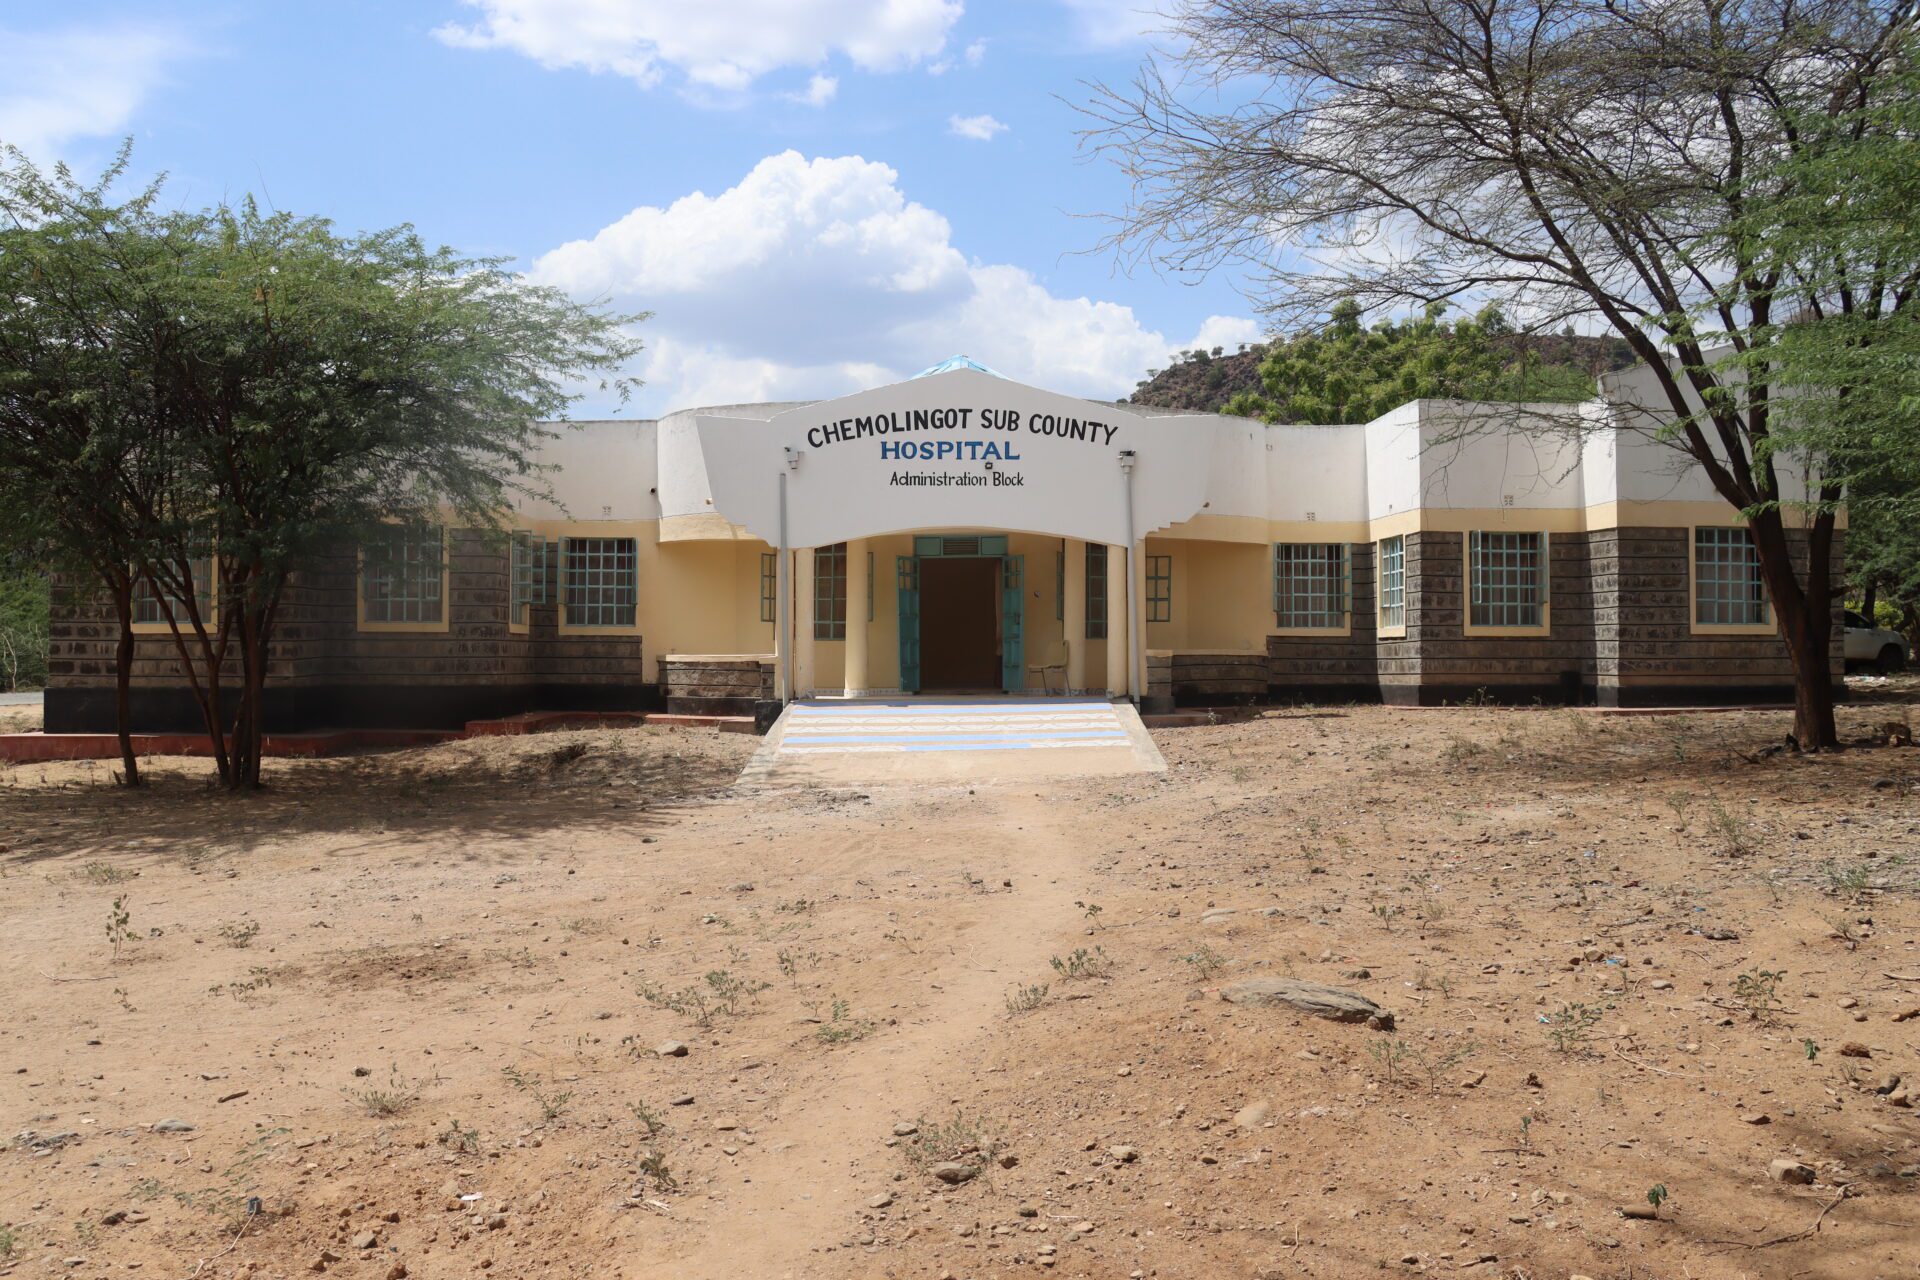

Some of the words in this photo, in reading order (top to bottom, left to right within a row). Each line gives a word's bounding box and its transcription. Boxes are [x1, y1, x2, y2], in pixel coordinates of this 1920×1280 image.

[807, 408, 973, 449] CHEMOLINGOT
[980, 408, 1021, 432] SUB
[1028, 413, 1119, 446] COUNTY
[880, 440, 1021, 461] HOSPITAL
[890, 471, 987, 487] Administration
[992, 471, 1024, 487] Block
